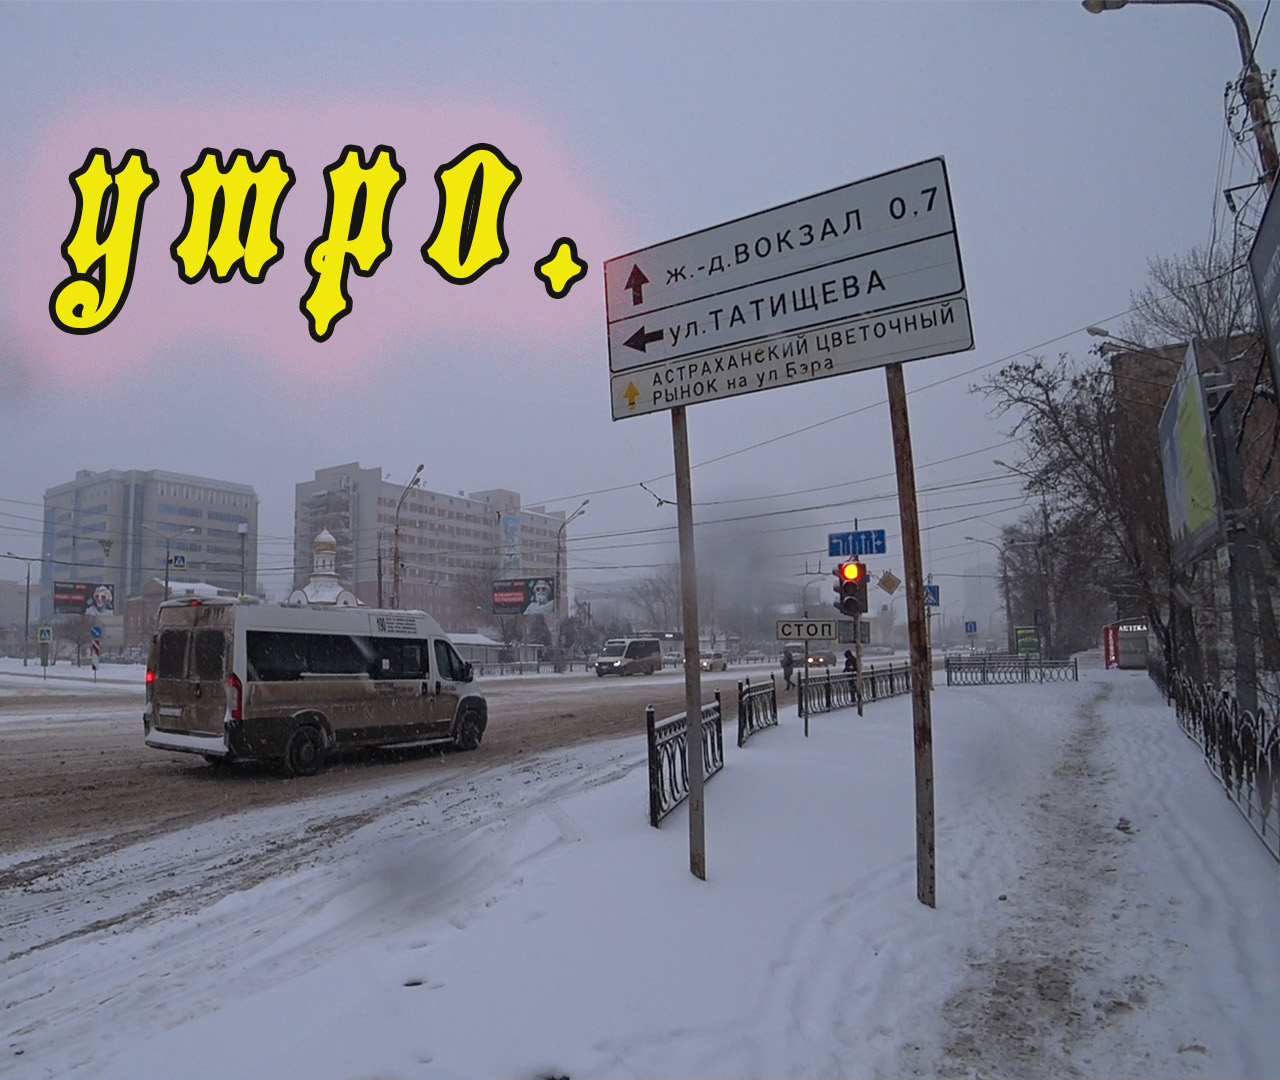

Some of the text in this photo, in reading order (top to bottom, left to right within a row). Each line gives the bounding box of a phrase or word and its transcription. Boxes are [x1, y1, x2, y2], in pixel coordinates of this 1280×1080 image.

[889, 186, 938, 220] 0,7
[669, 269, 886, 347] ул.ТАТИЩЕВА
[816, 301, 955, 351] ЦВЕТОЧНЫЙ
[653, 356, 834, 405] РЫНОК на ул Бэра
[781, 623, 833, 637] СТОП
